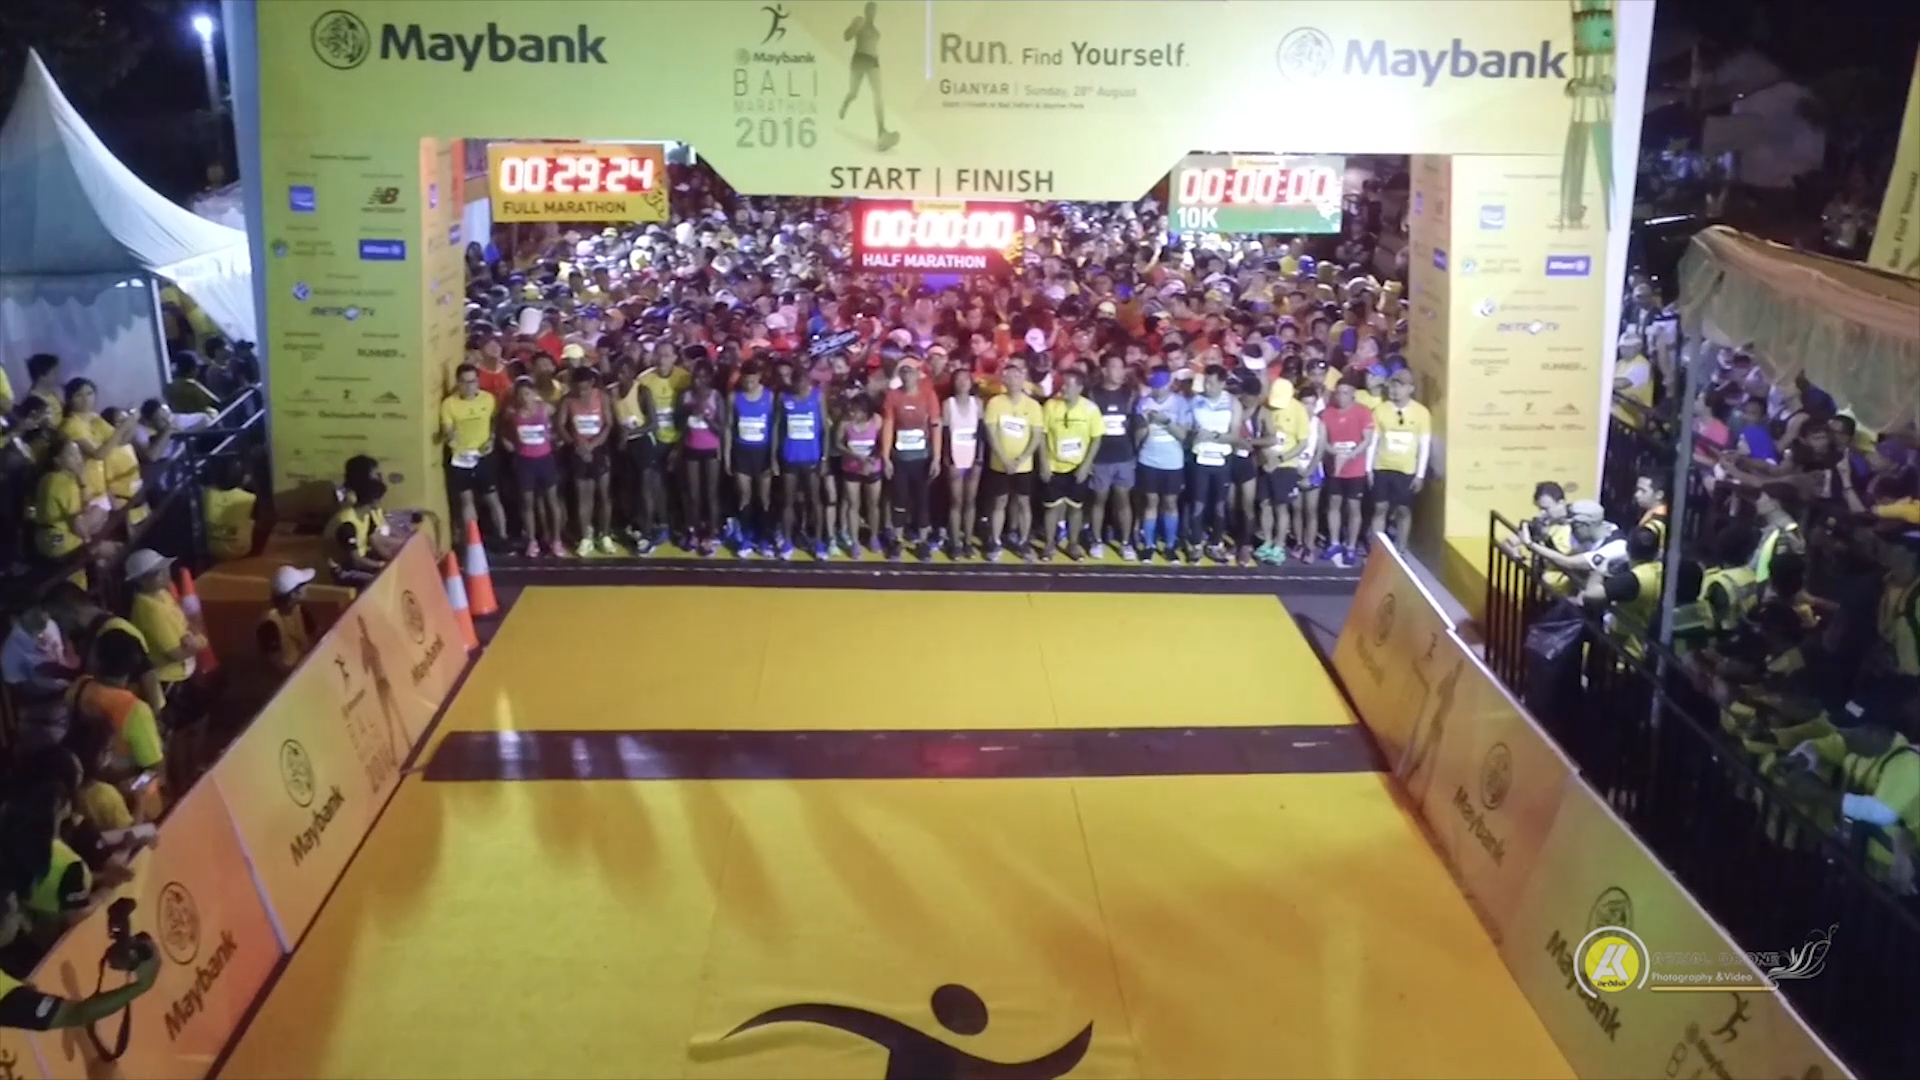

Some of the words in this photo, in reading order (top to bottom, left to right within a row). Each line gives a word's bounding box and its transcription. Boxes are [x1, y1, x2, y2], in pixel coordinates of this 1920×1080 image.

[380, 22, 607, 72] Maybank
[753, 51, 816, 65] Maybank
[939, 32, 1013, 65] Run.
[1022, 48, 1063, 65] Find
[1071, 41, 1190, 67] Yourself.
[1343, 38, 1568, 87] Maybank
[734, 68, 818, 97] BALI
[735, 117, 818, 148] 2016
[500, 157, 654, 193] 00:29:24
[830, 166, 921, 190] START
[956, 169, 1053, 193] FINISH
[1180, 167, 1335, 205] 00:00:00
[503, 201, 540, 214] FULL
[544, 202, 627, 214] MARATHON
[1177, 206, 1218, 229] 10K
[862, 209, 1015, 250] 00:00:00
[863, 253, 901, 268] HALF
[904, 253, 987, 269] MARATHON
[290, 784, 346, 867] Maybank
[1453, 783, 1506, 869] Maybank
[164, 929, 238, 1042] Maybank
